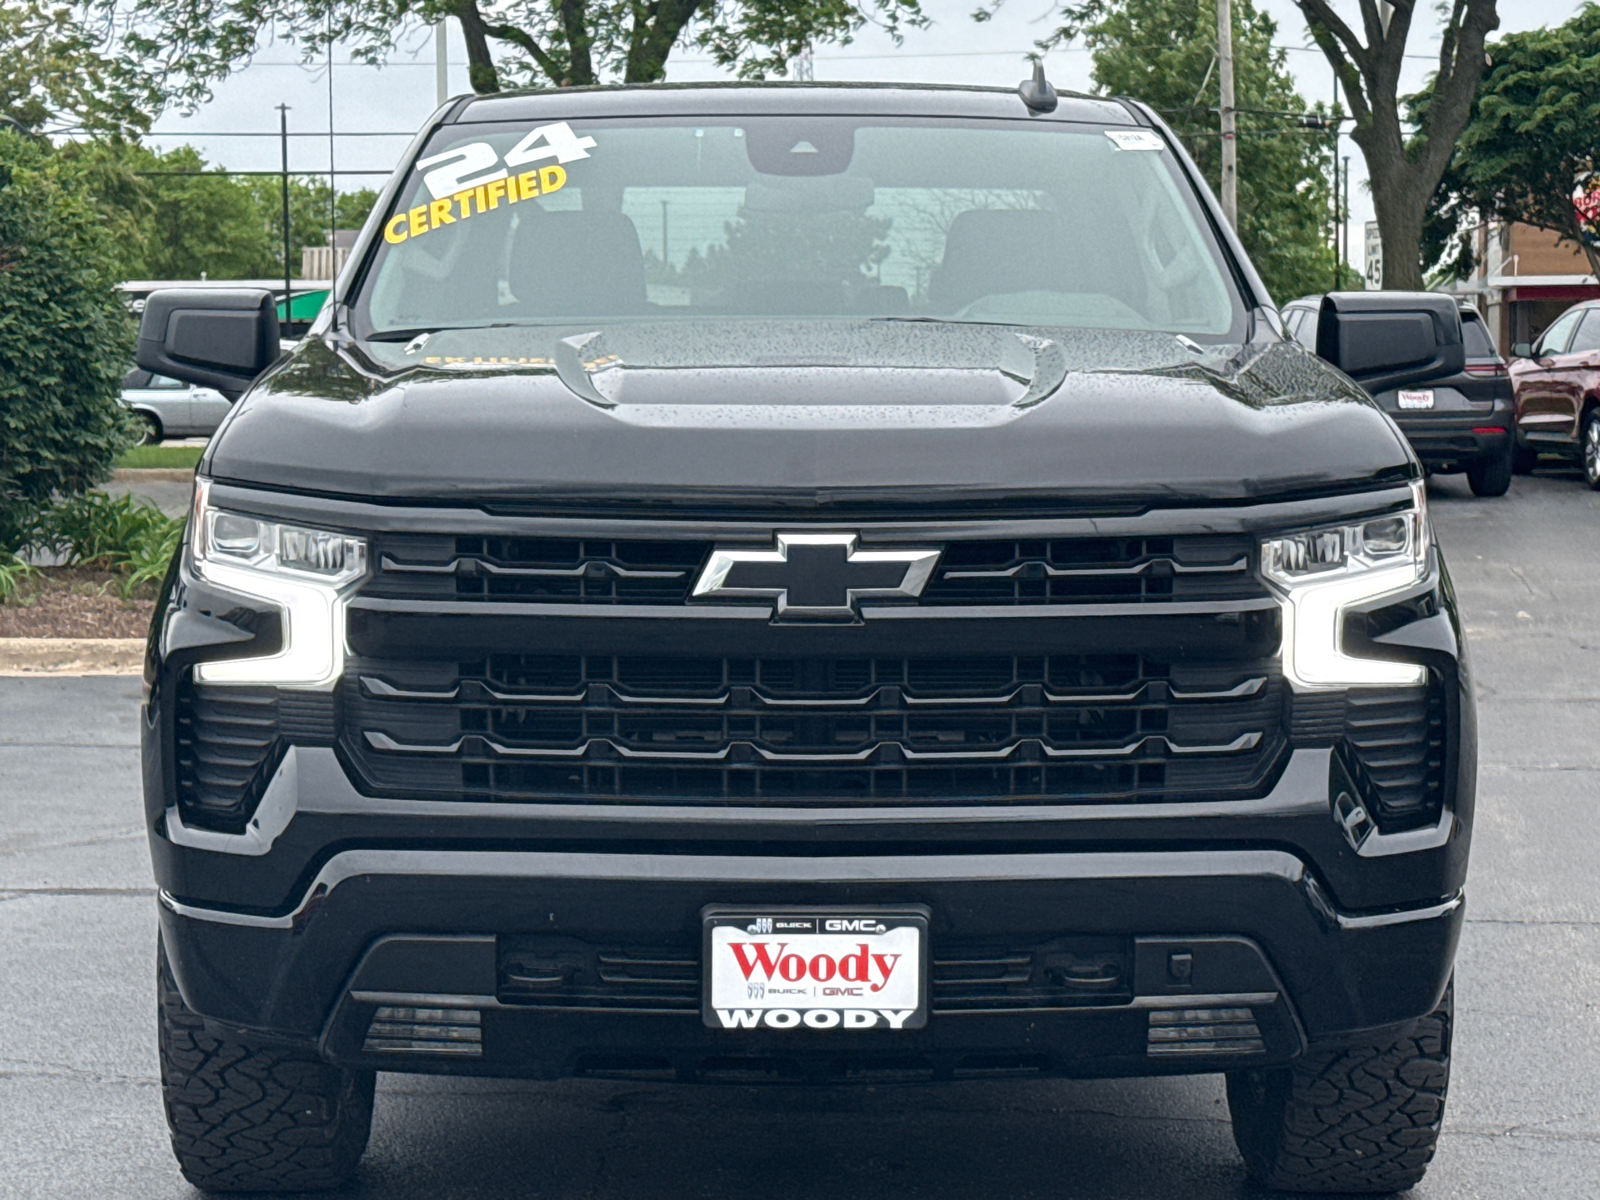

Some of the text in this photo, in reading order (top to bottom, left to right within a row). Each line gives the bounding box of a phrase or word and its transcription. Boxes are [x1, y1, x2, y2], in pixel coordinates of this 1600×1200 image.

[416, 121, 598, 200] 24
[384, 165, 567, 244] CERTIFIED
[1366, 258, 1381, 288] 45
[824, 919, 877, 932] GMC
[727, 942, 902, 993] Woody
[767, 986, 864, 997] BUICK GMC
[715, 1008, 915, 1029] WOODY
